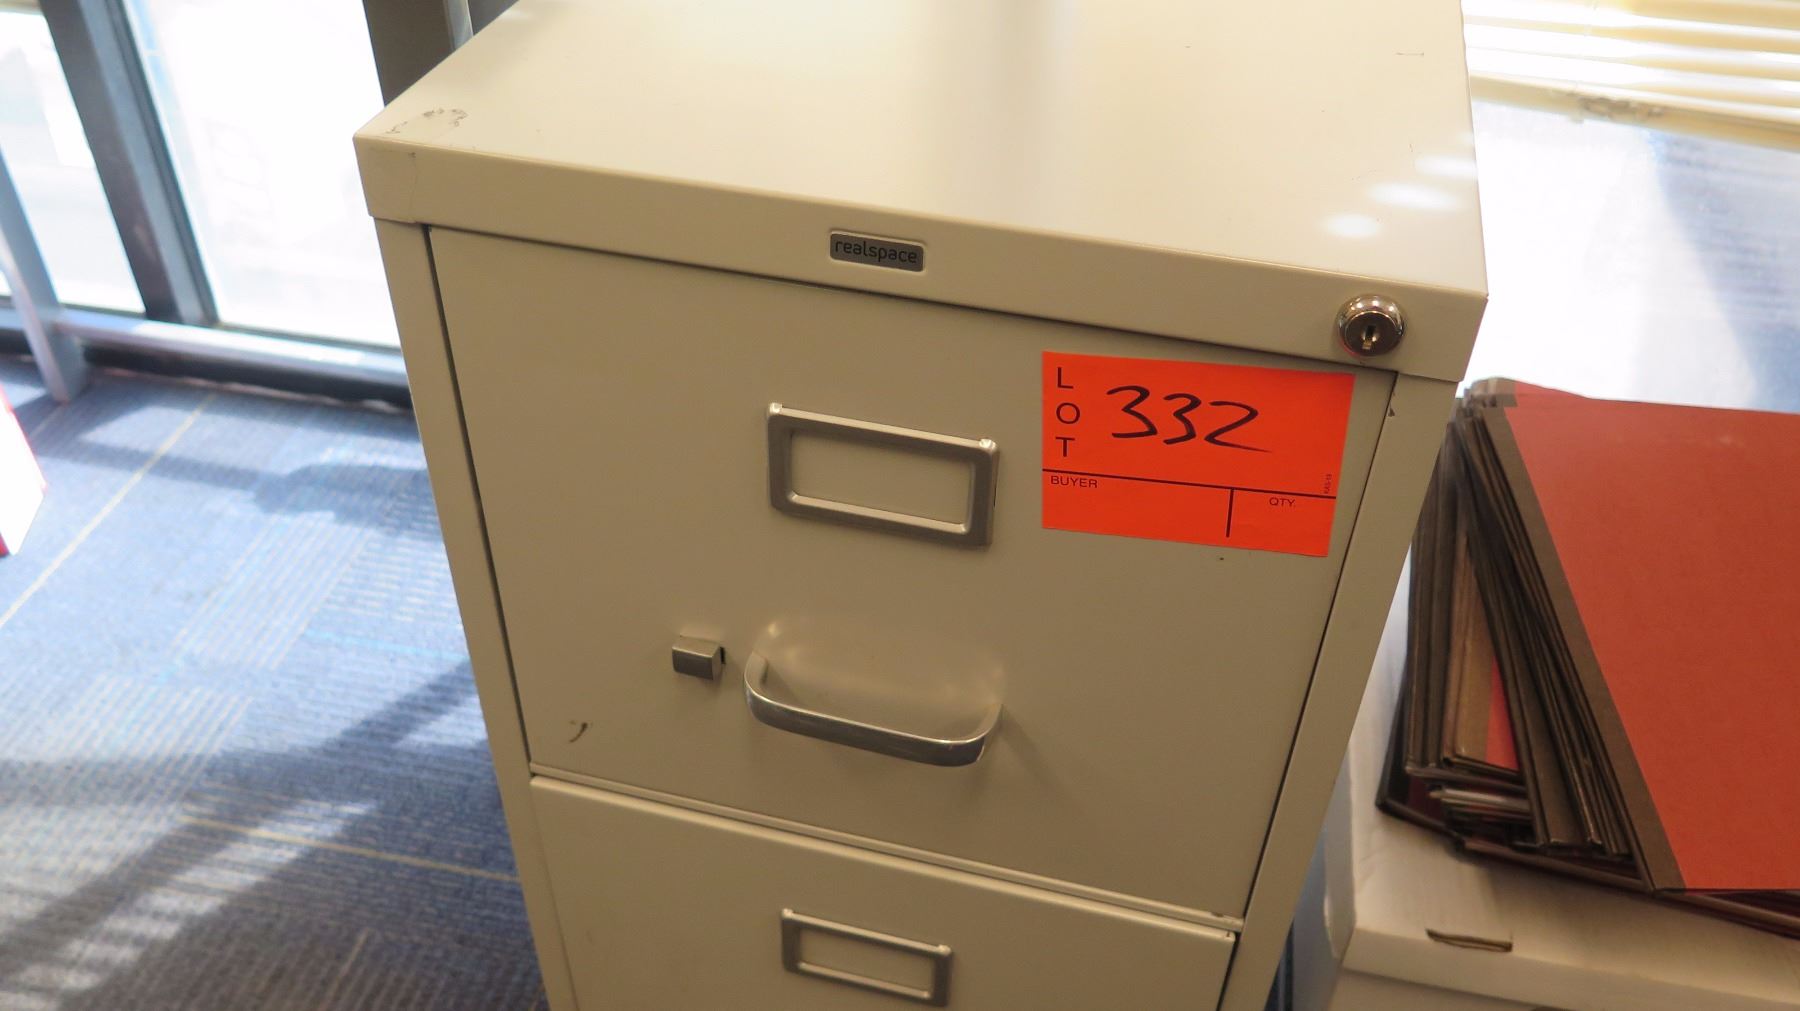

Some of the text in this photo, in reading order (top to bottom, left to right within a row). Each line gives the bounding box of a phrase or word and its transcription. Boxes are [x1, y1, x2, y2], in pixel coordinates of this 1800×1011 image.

[835, 240, 917, 263] realspace
[1055, 366, 1081, 457] LOT
[1106, 385, 1273, 453] 332
[1050, 475, 1098, 489] BUYER
